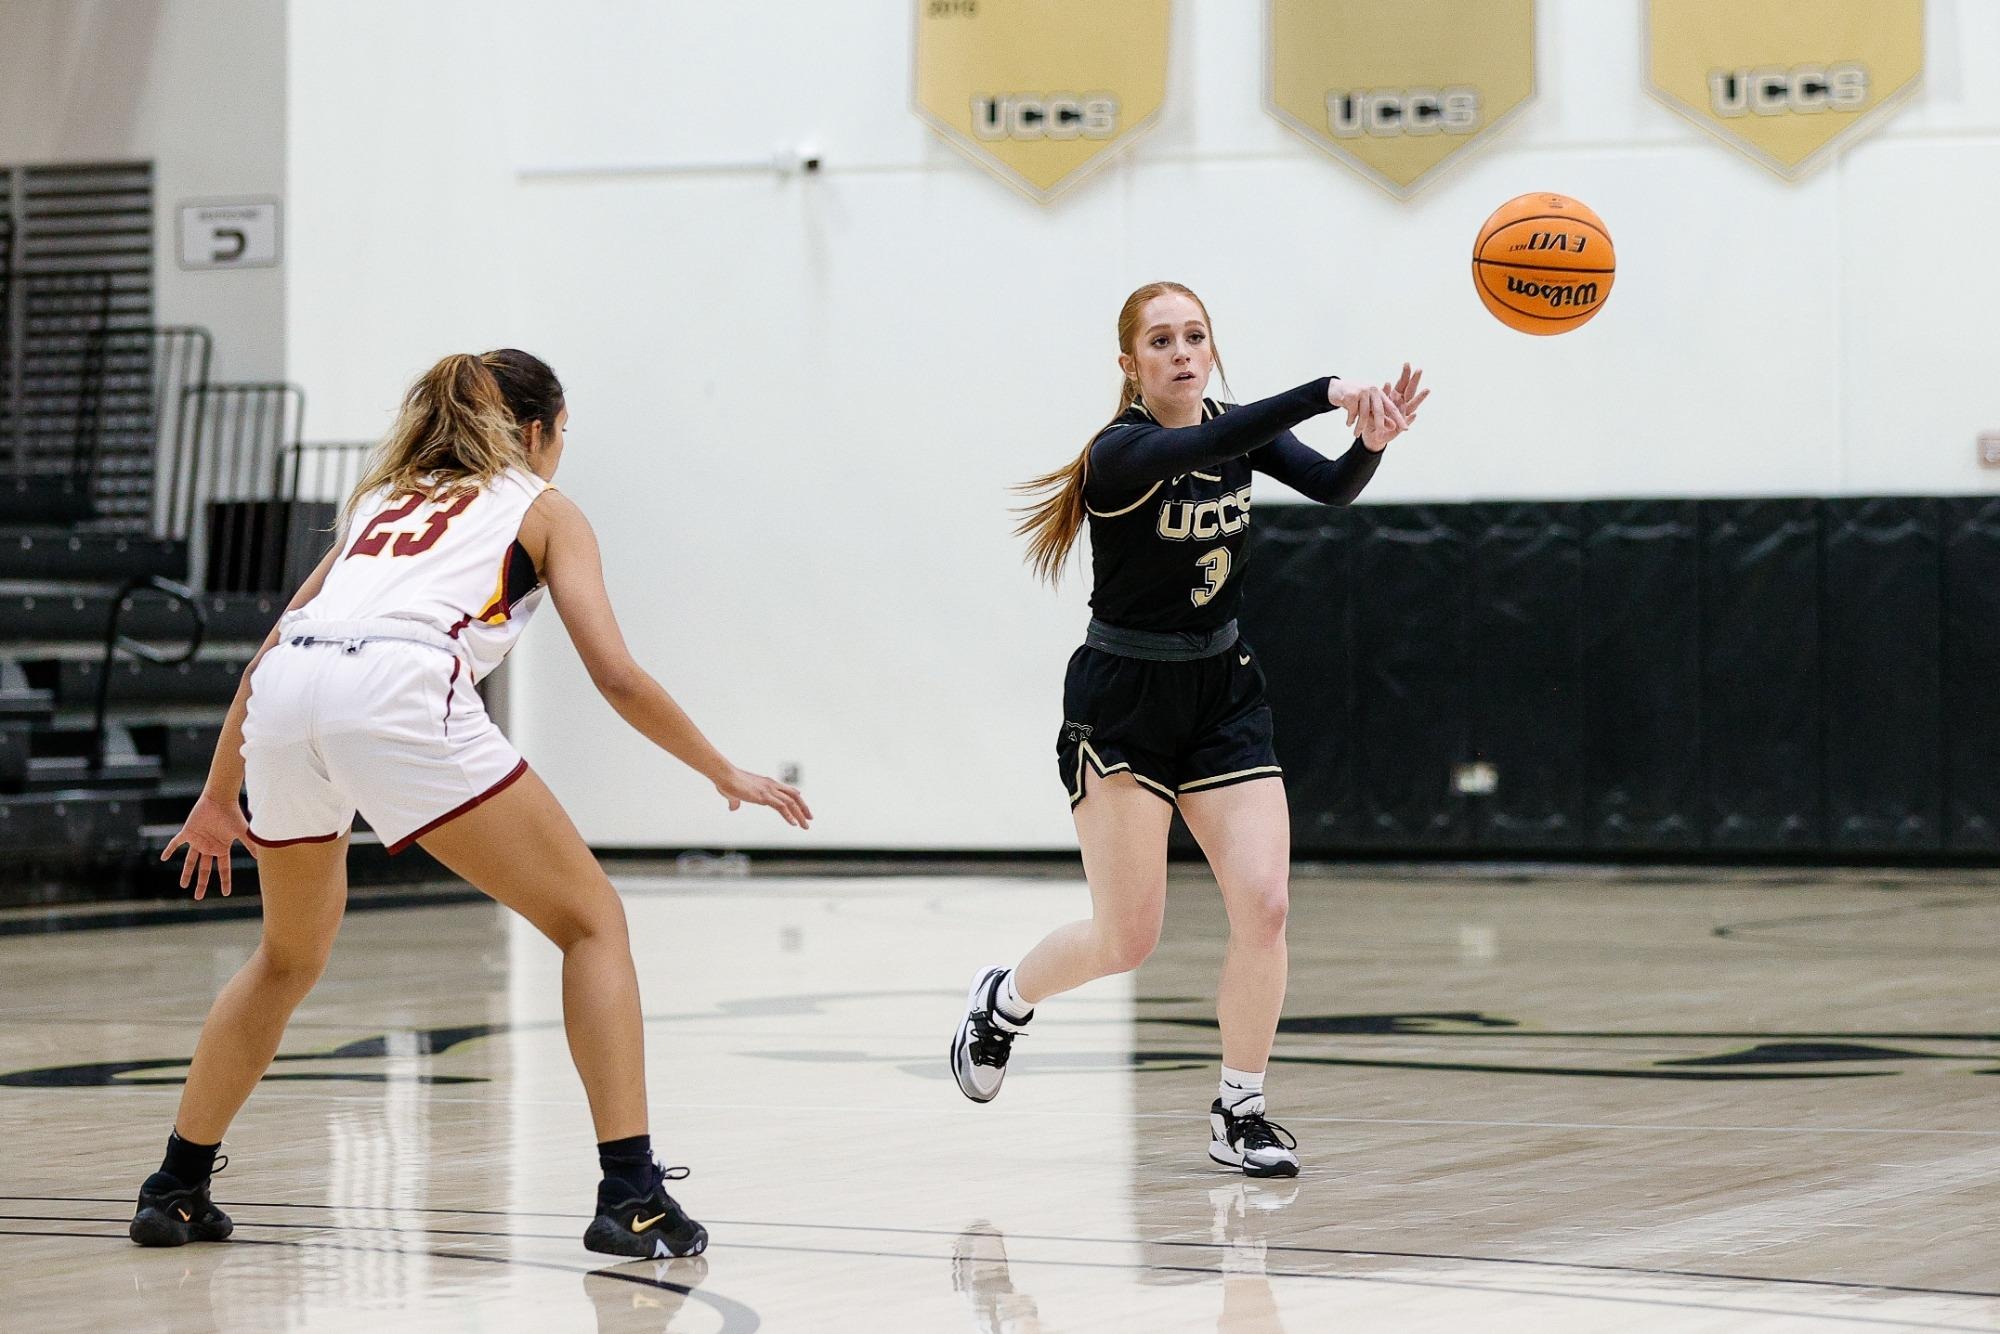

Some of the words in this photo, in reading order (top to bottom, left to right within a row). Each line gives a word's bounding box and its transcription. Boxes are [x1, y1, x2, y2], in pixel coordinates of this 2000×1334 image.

[1327, 86, 1481, 138] UCCS
[1709, 61, 1868, 117] UCCS
[972, 91, 1119, 140] UCCS
[1528, 231, 1587, 254] EVO
[1507, 275, 1598, 307] Wilson
[345, 484, 480, 561] 23
[1191, 546, 1231, 608] 3
